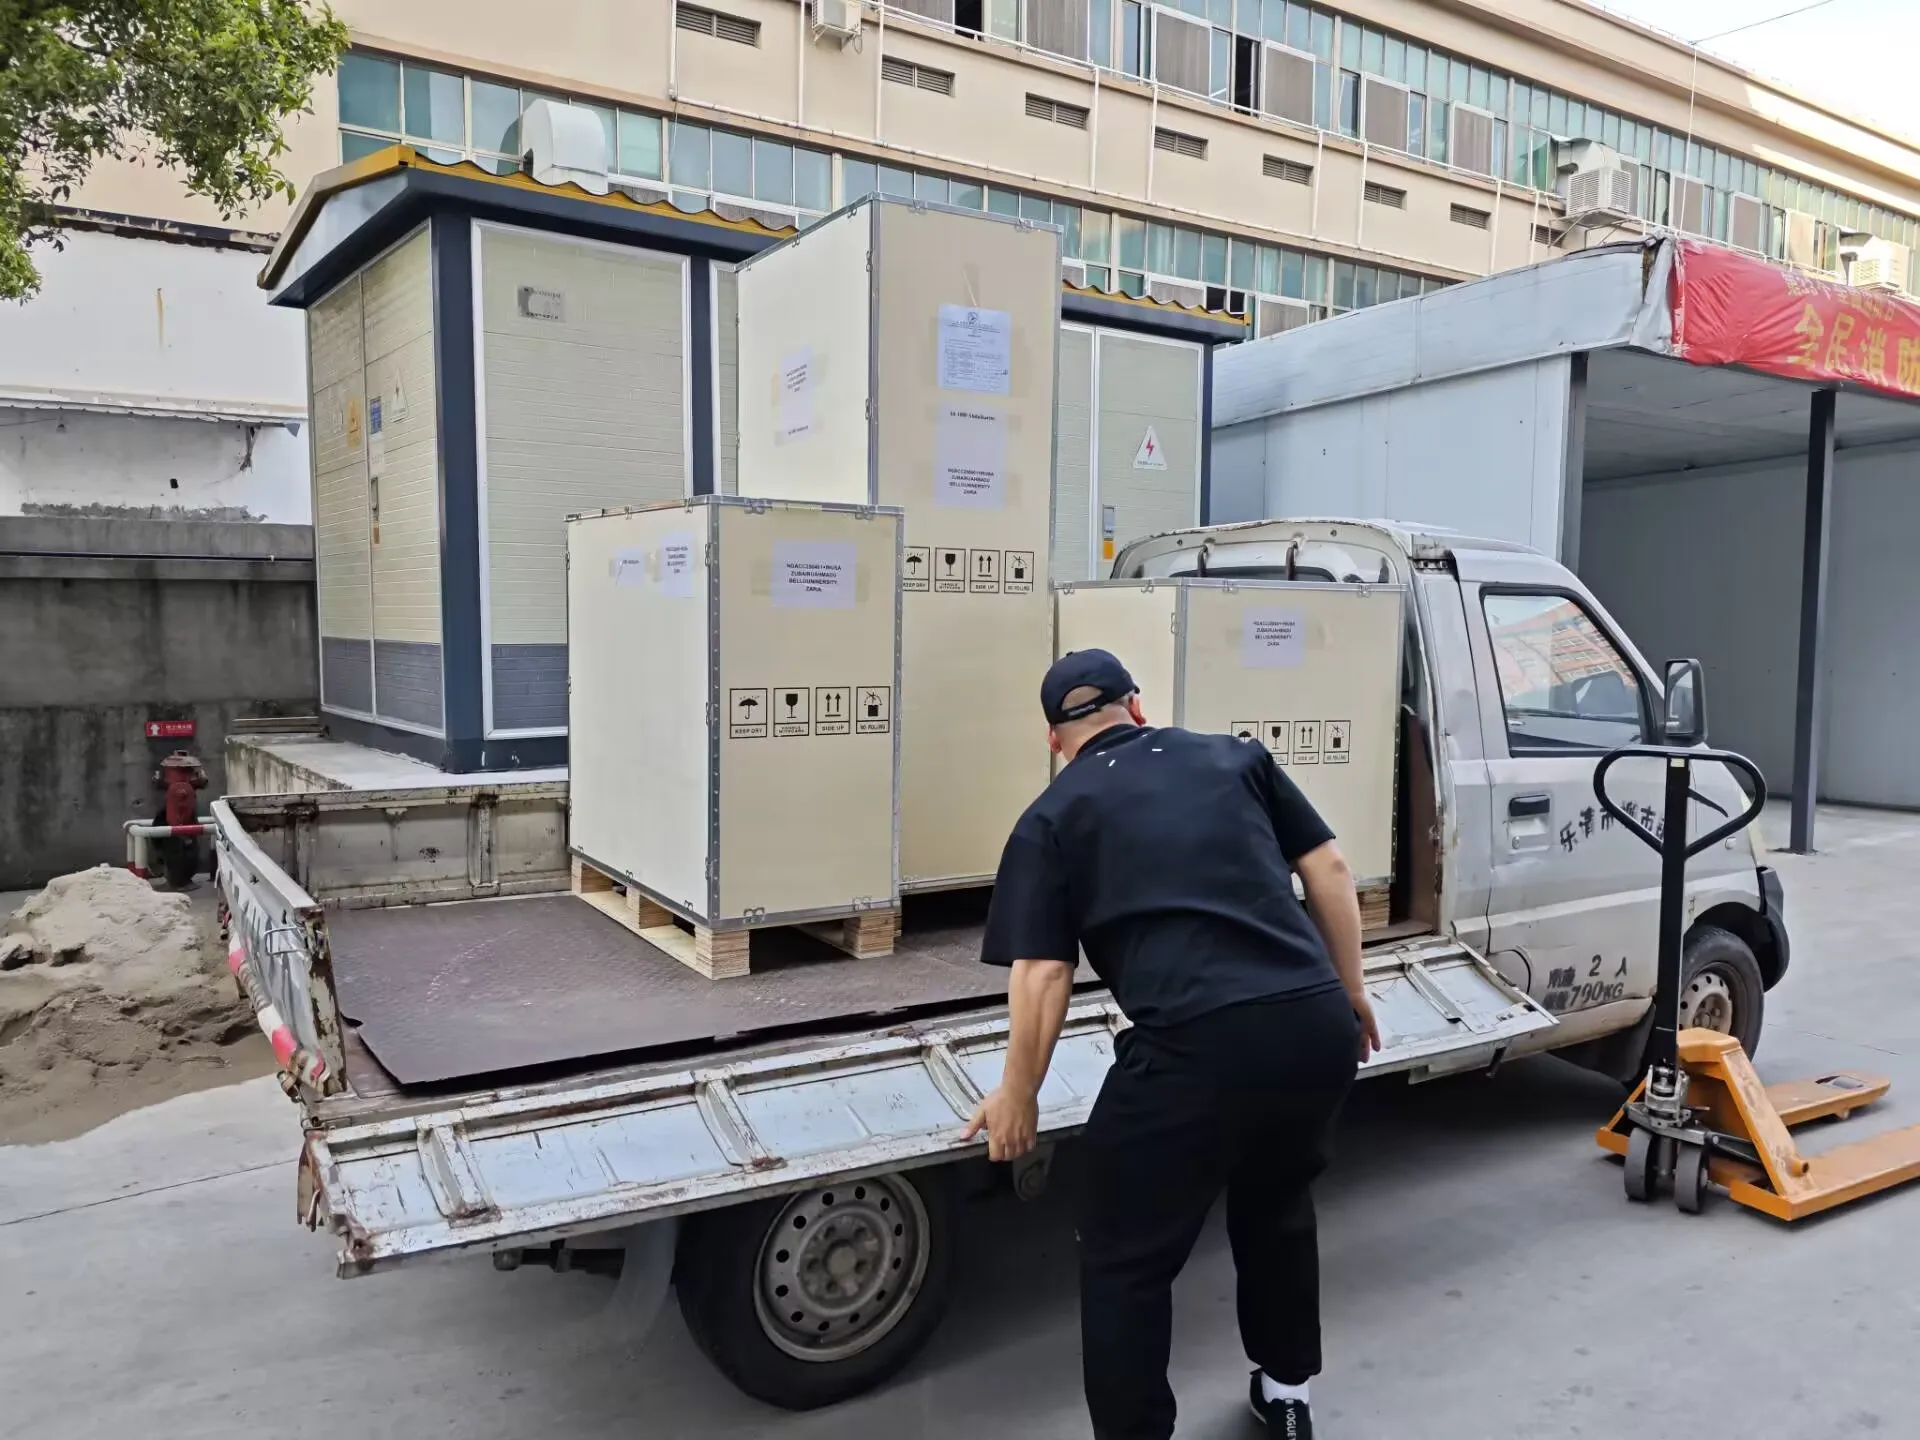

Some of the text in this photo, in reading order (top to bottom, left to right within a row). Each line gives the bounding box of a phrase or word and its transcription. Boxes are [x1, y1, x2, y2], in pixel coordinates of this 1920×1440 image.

[1589, 954, 1602, 977] 2
[1615, 956, 1627, 978] 人
[1286, 1407, 1297, 1440] VOGUE
